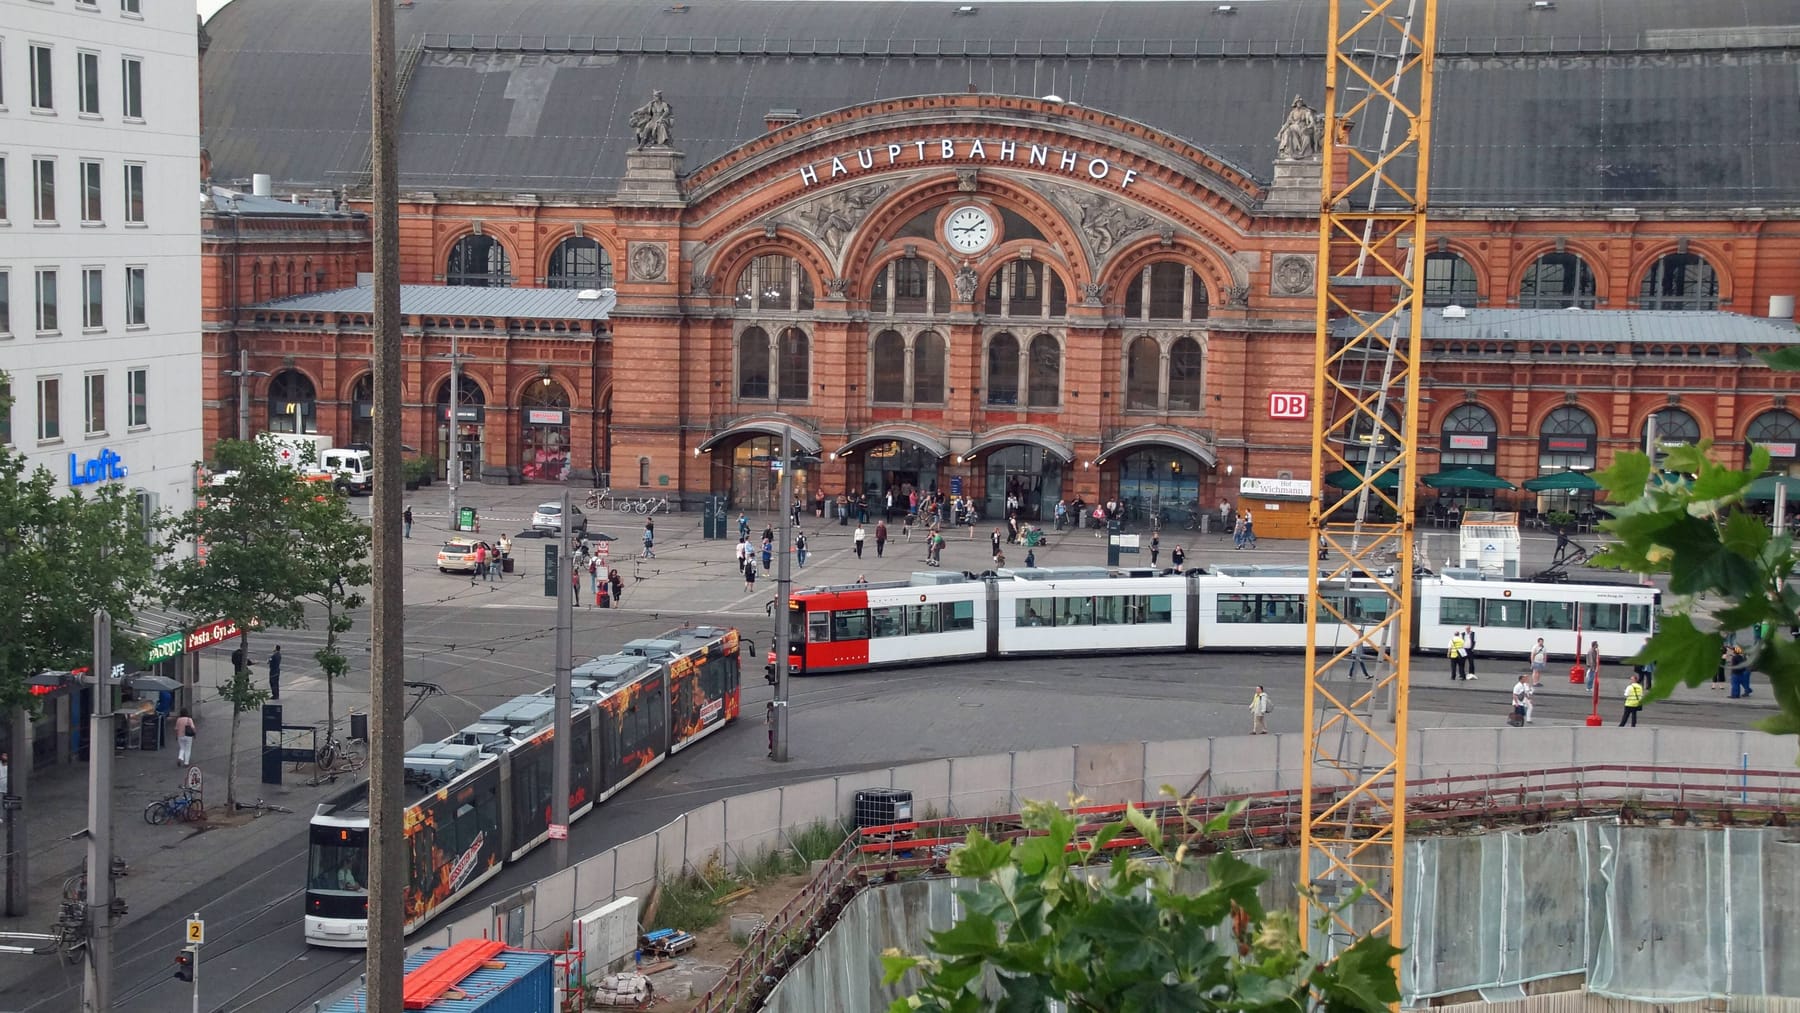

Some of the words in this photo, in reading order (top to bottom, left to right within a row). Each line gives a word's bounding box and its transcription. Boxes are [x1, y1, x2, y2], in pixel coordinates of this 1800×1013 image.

[800, 139, 1137, 189] HAUPTBAHNHOF
[1272, 395, 1304, 416] DB
[1260, 485, 1304, 495] Wichmann
[110, 663, 125, 679] AFE
[191, 925, 200, 938] 2
